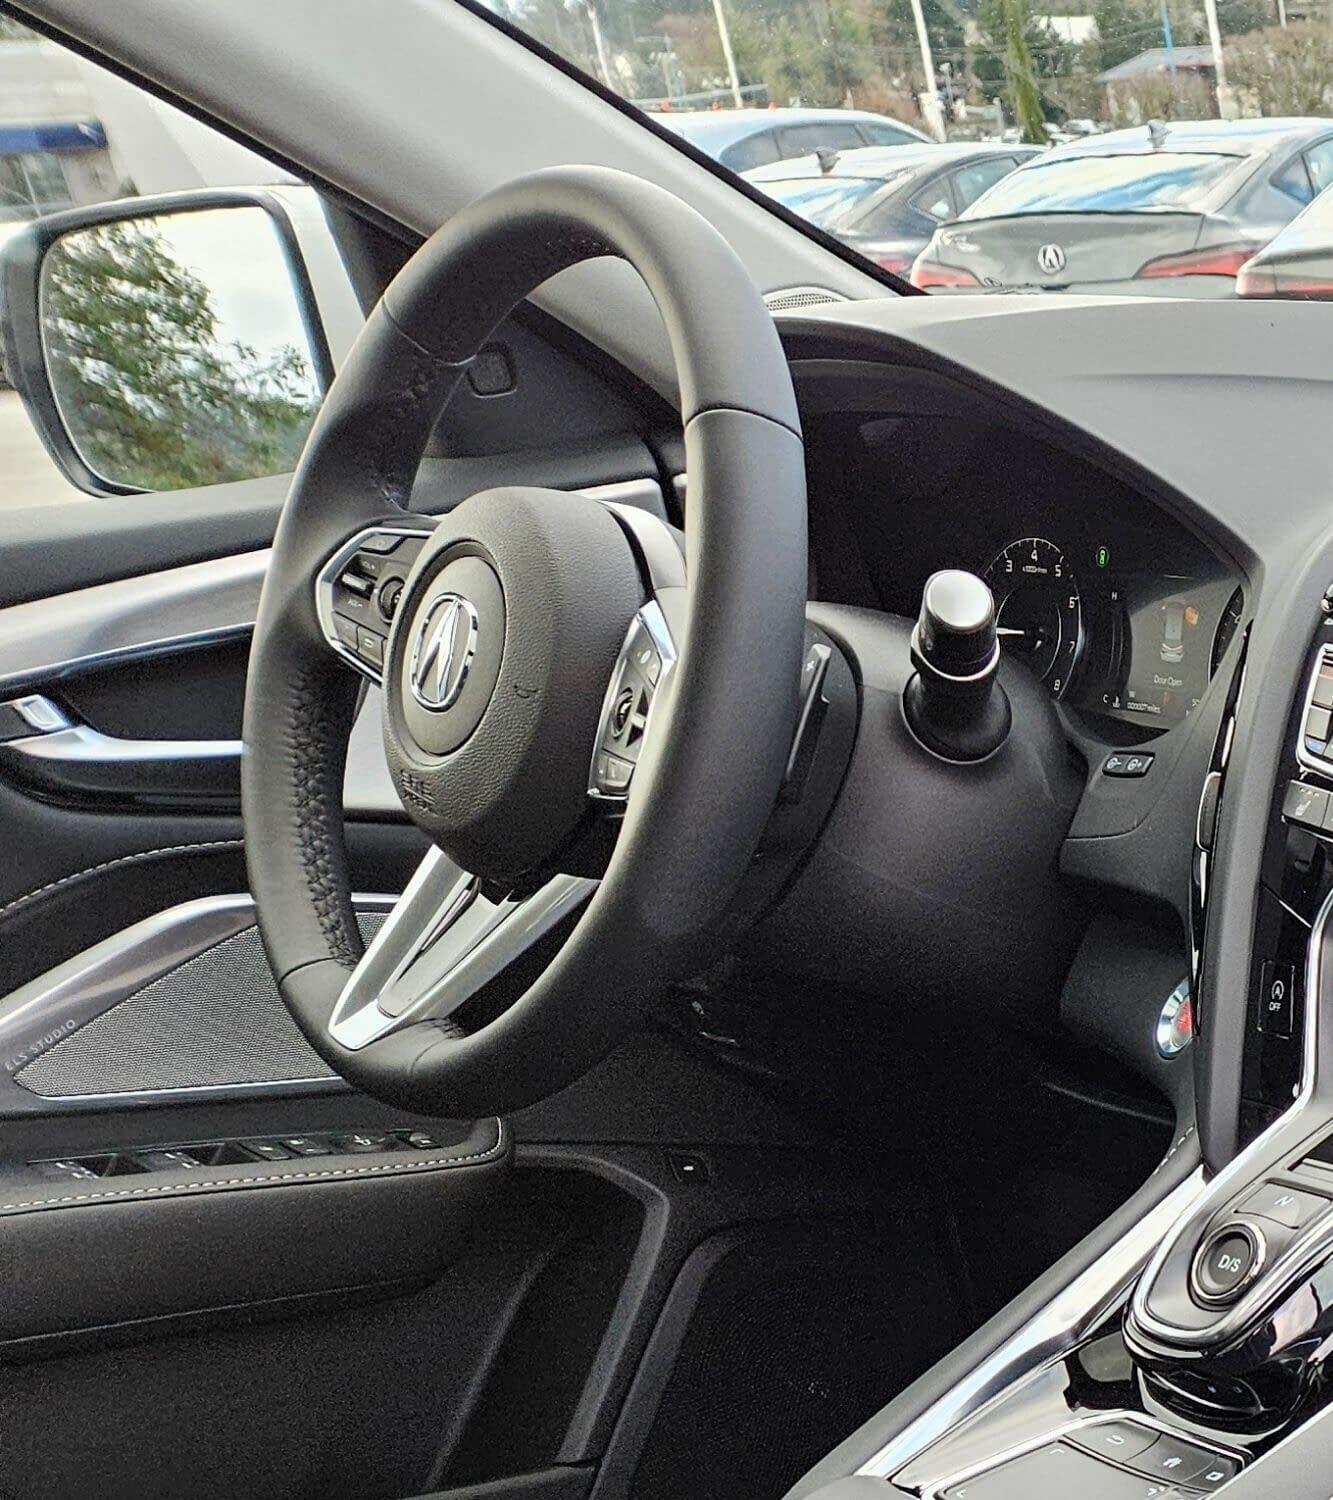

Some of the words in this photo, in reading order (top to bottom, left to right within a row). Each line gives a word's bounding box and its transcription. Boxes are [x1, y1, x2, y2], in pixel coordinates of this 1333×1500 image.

[1006, 560, 1013, 572] 3
[1055, 564, 1061, 577] 5
[1069, 596, 1076, 608] 6
[1068, 641, 1075, 653] 7
[1054, 679, 1060, 690] 8
[1103, 694, 1108, 703] C
[1268, 1002, 1281, 1011] OFF
[1274, 1196, 1290, 1207] N
[1217, 1254, 1241, 1273] D/S
